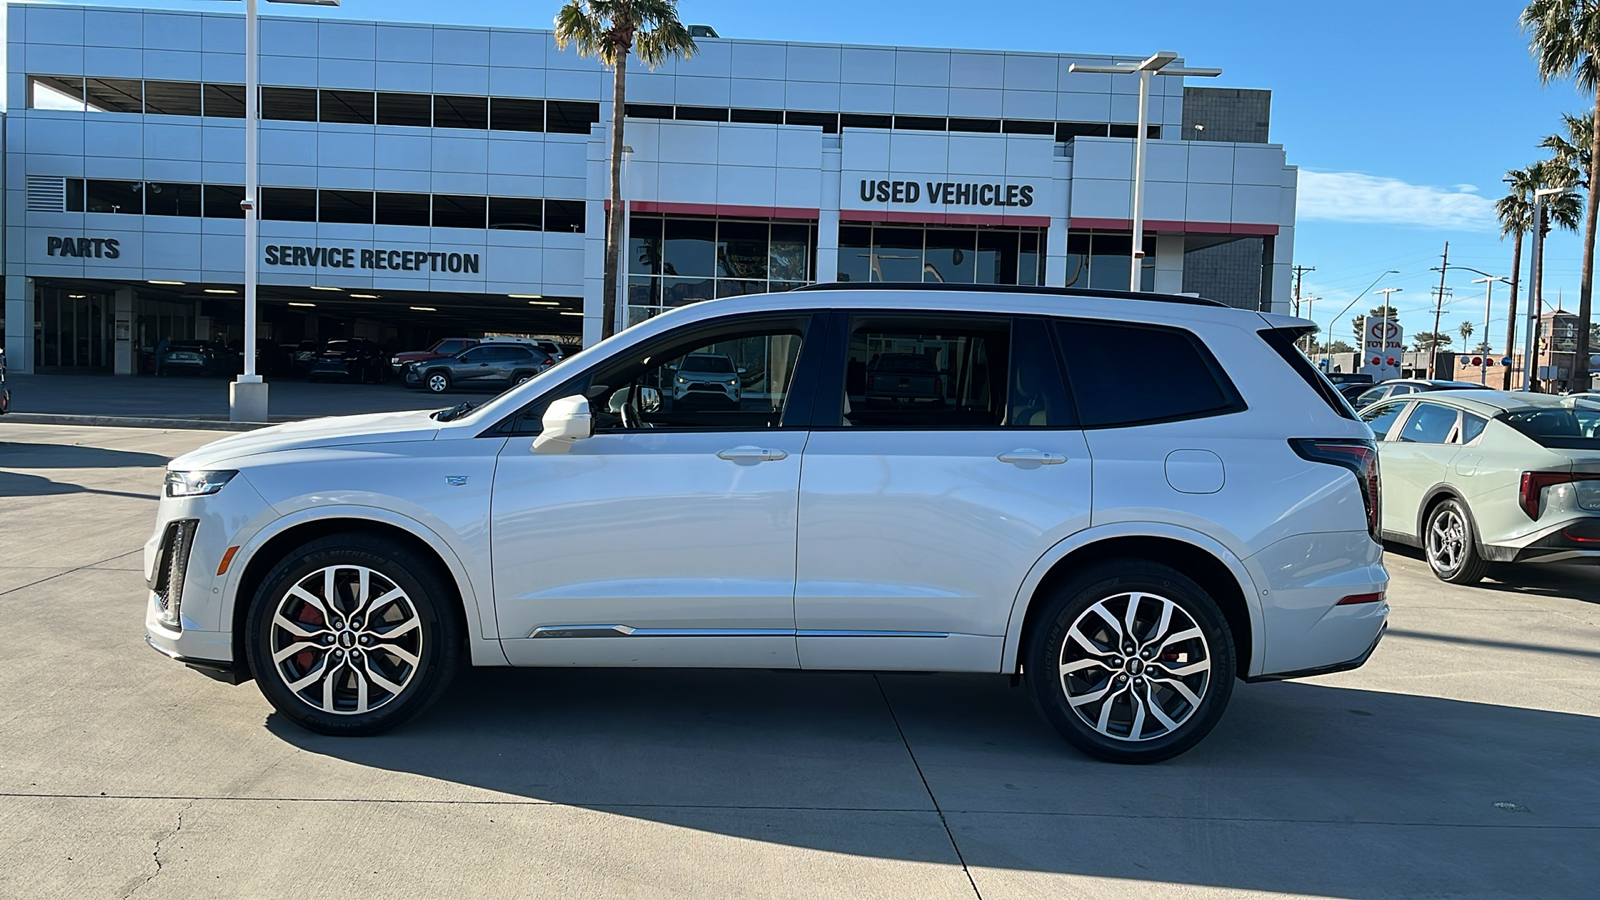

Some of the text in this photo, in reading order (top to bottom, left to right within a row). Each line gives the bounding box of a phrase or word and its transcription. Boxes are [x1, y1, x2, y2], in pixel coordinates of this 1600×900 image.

[860, 179, 1034, 207] USED VEHICLES
[47, 236, 120, 259] PARTS
[264, 245, 479, 273] SERVICE RECEPTION
[329, 549, 386, 564] MICHELIN
